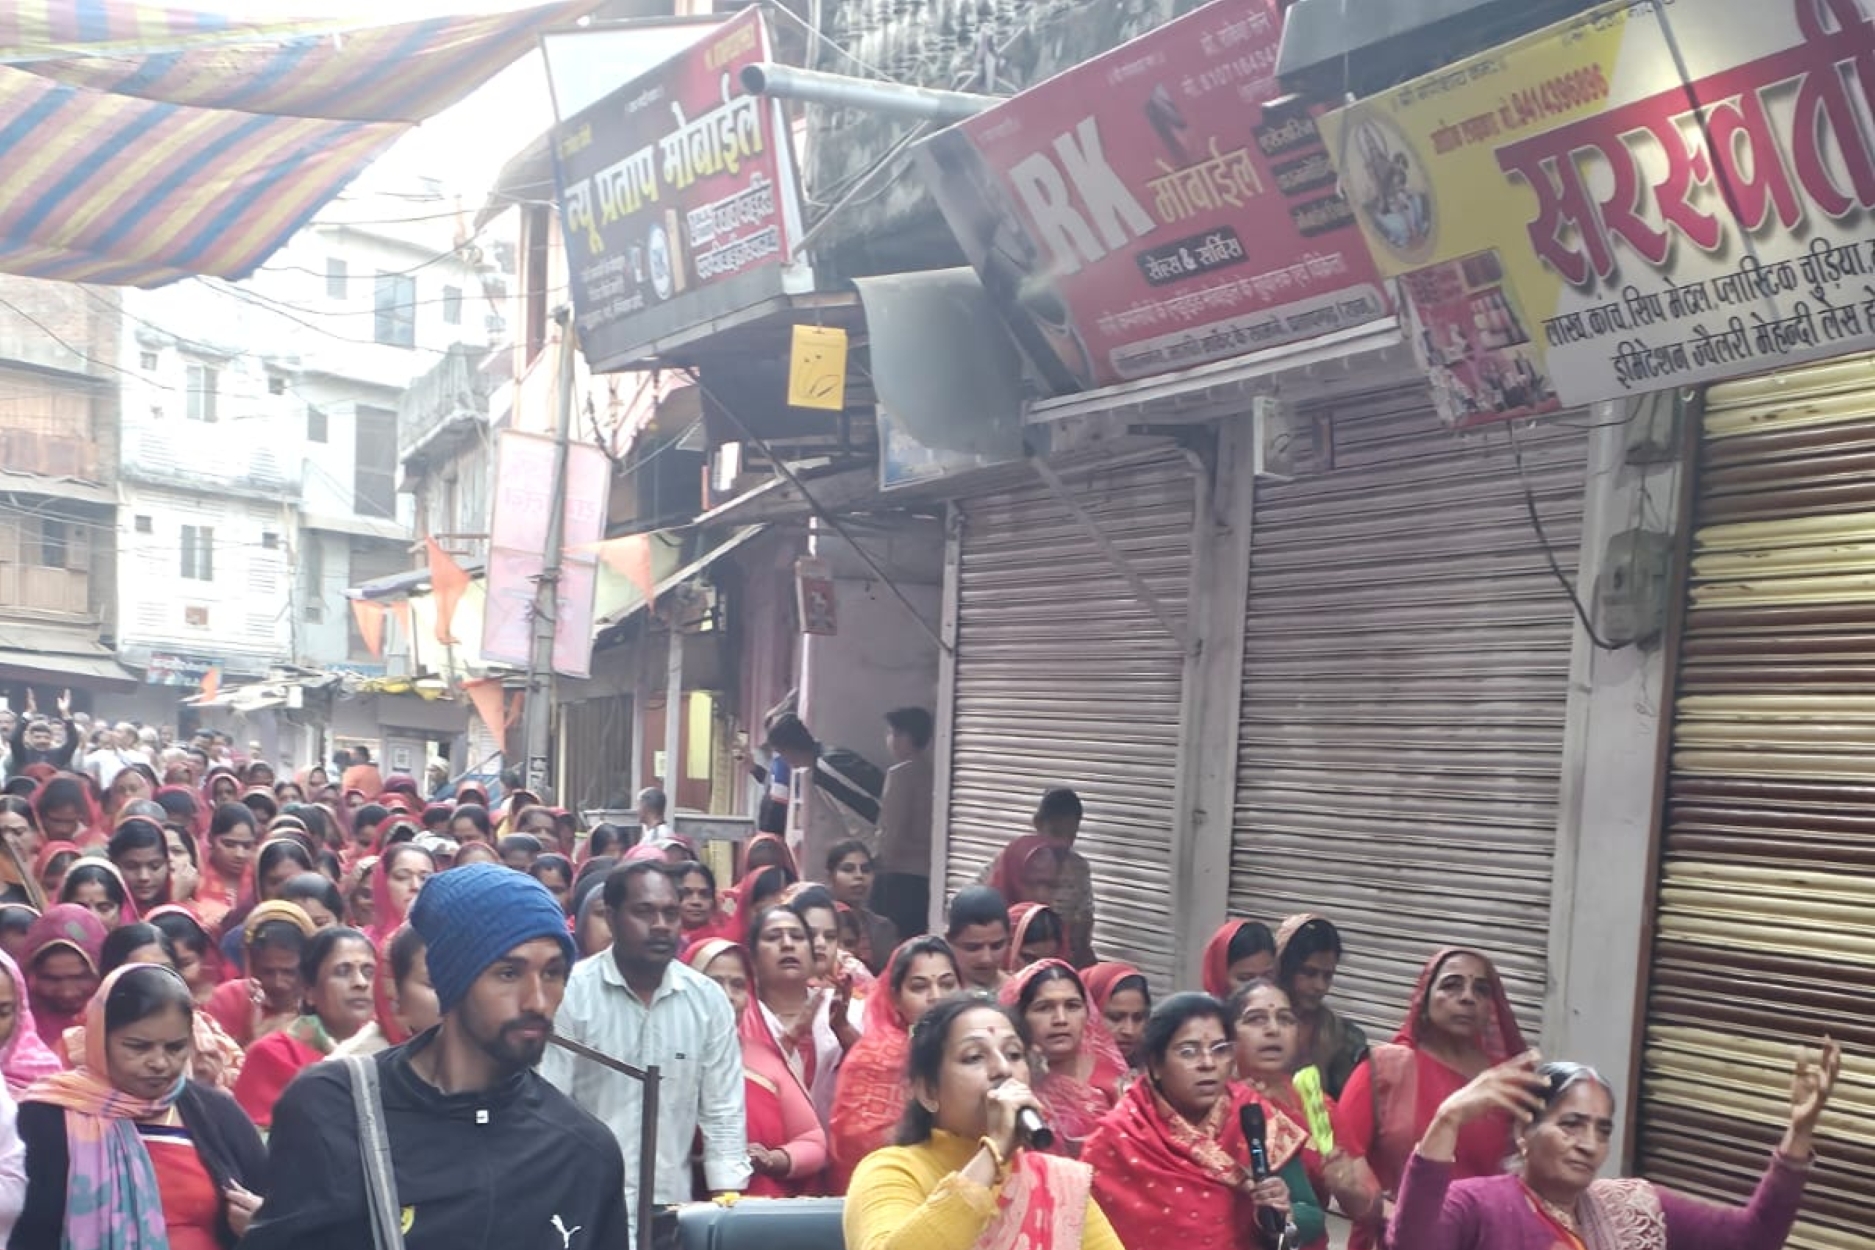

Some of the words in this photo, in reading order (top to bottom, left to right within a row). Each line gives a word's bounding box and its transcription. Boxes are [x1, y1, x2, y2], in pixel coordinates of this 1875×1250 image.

[594, 145, 660, 227] प्रताप
[659, 73, 764, 190] मोबाईल
[1009, 115, 1158, 276] RK
[1145, 136, 1264, 224] मोबाईल
[1145, 255, 1184, 281] सेल्स
[1196, 233, 1244, 266] सर्विस
